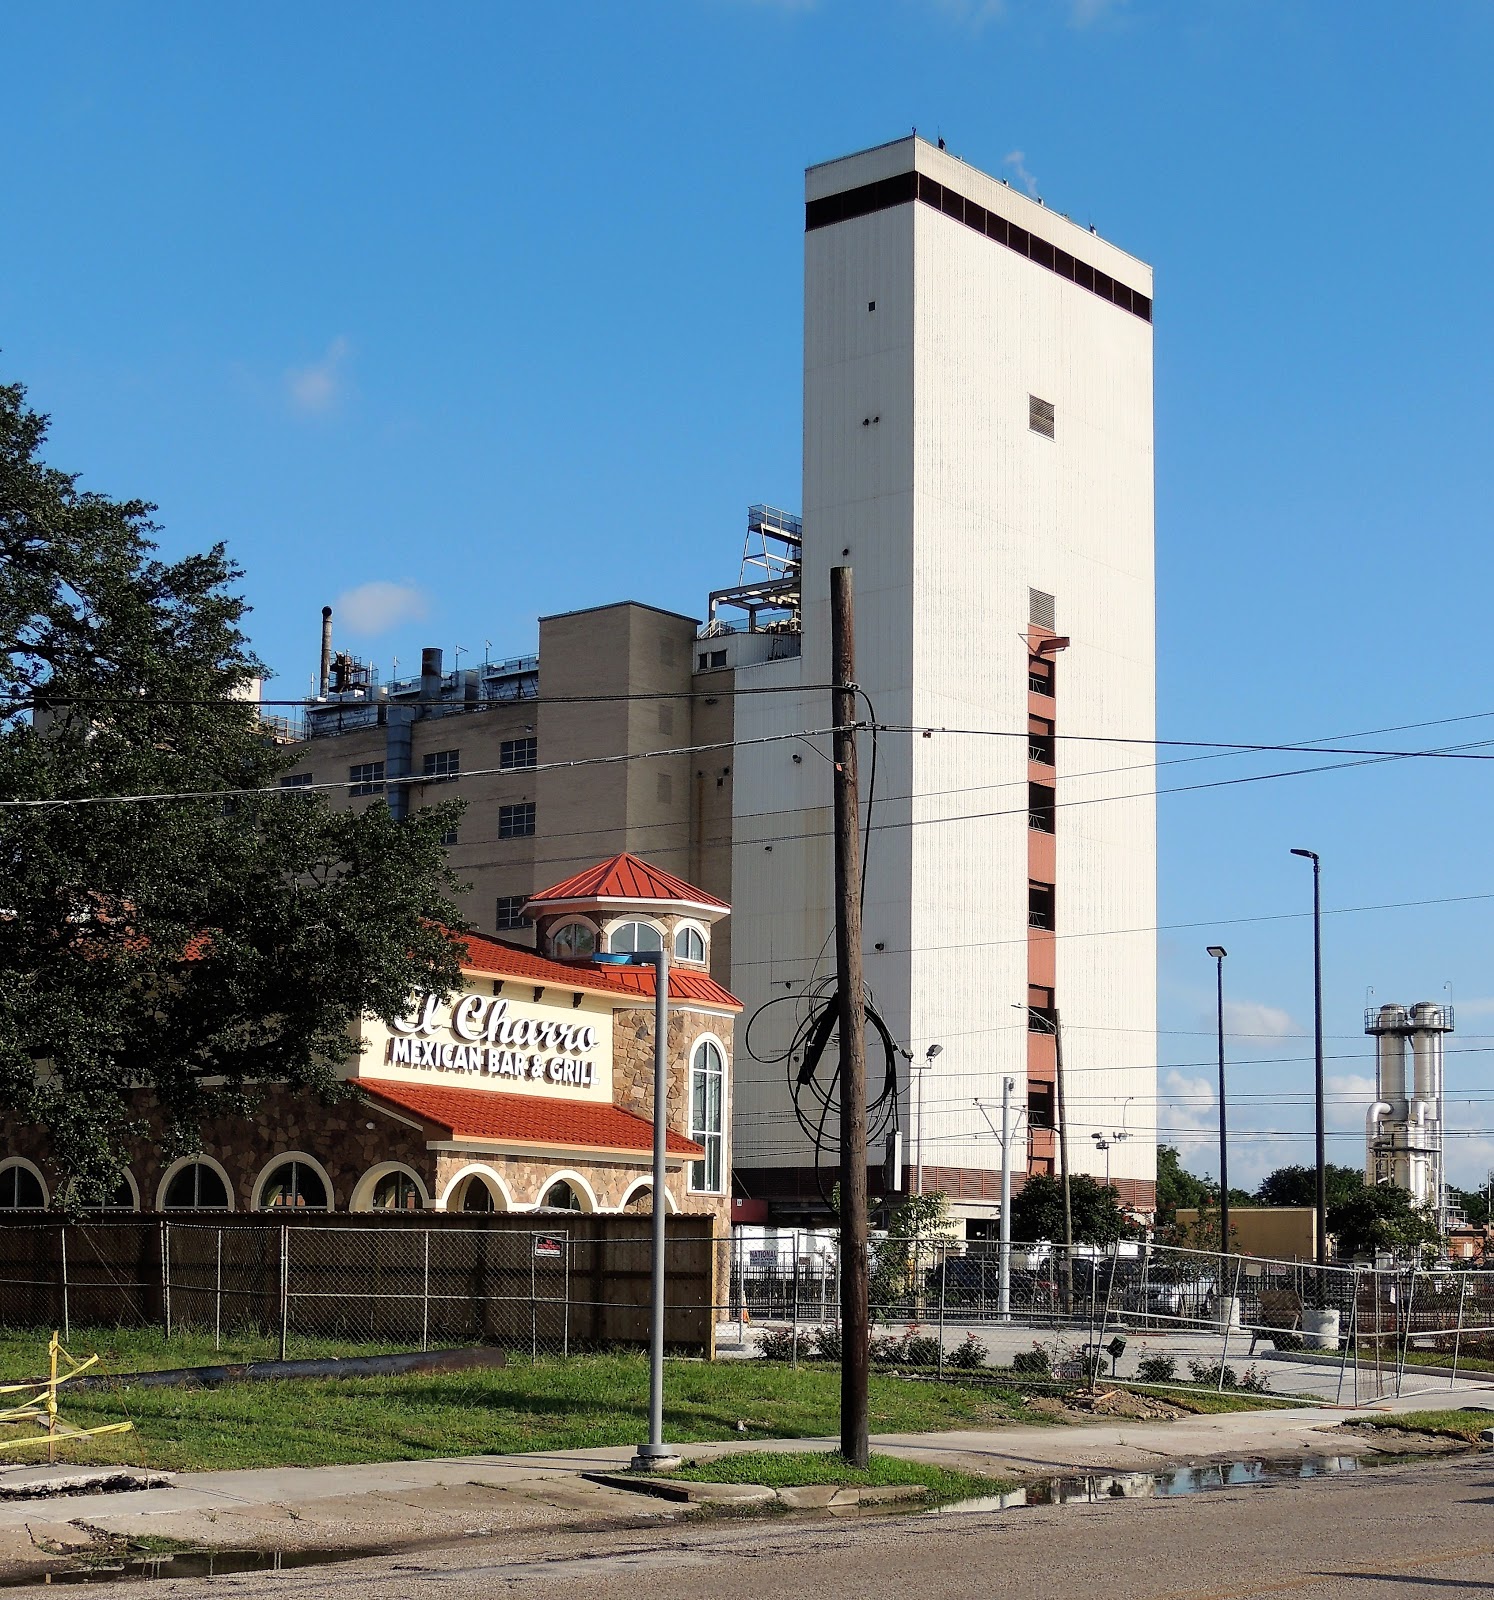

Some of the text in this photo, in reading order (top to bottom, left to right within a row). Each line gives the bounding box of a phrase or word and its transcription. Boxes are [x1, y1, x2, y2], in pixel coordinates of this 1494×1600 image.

[456, 994, 600, 1052] Charro
[392, 1037, 600, 1085] MEXICAN BAR & GRILL
[750, 1250, 776, 1258] NATIONAL
